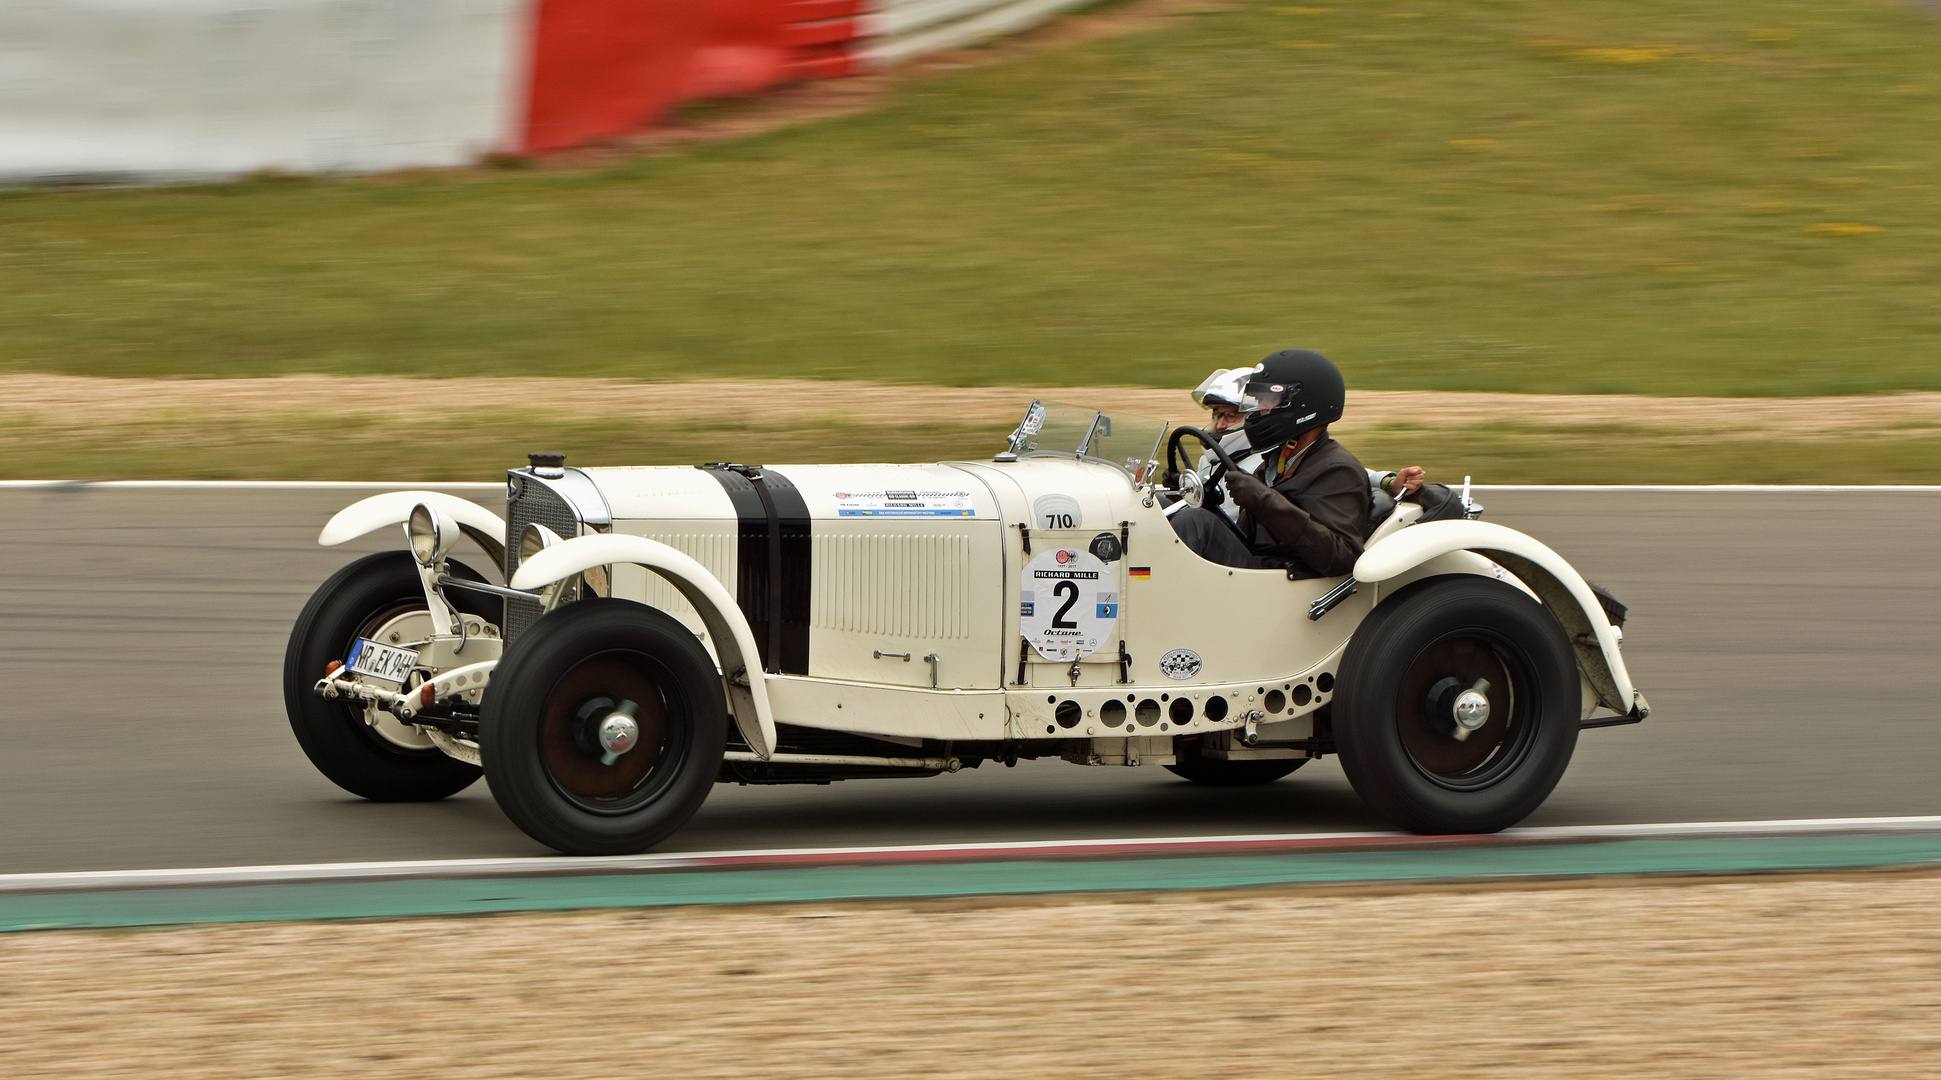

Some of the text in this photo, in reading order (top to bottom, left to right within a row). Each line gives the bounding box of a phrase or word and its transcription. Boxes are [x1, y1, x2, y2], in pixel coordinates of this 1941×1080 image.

[1035, 570, 1098, 579] RICHARD MILLE
[1051, 580, 1080, 629] 2
[1043, 628, 1082, 636] Octane
[373, 649, 396, 675] EK
